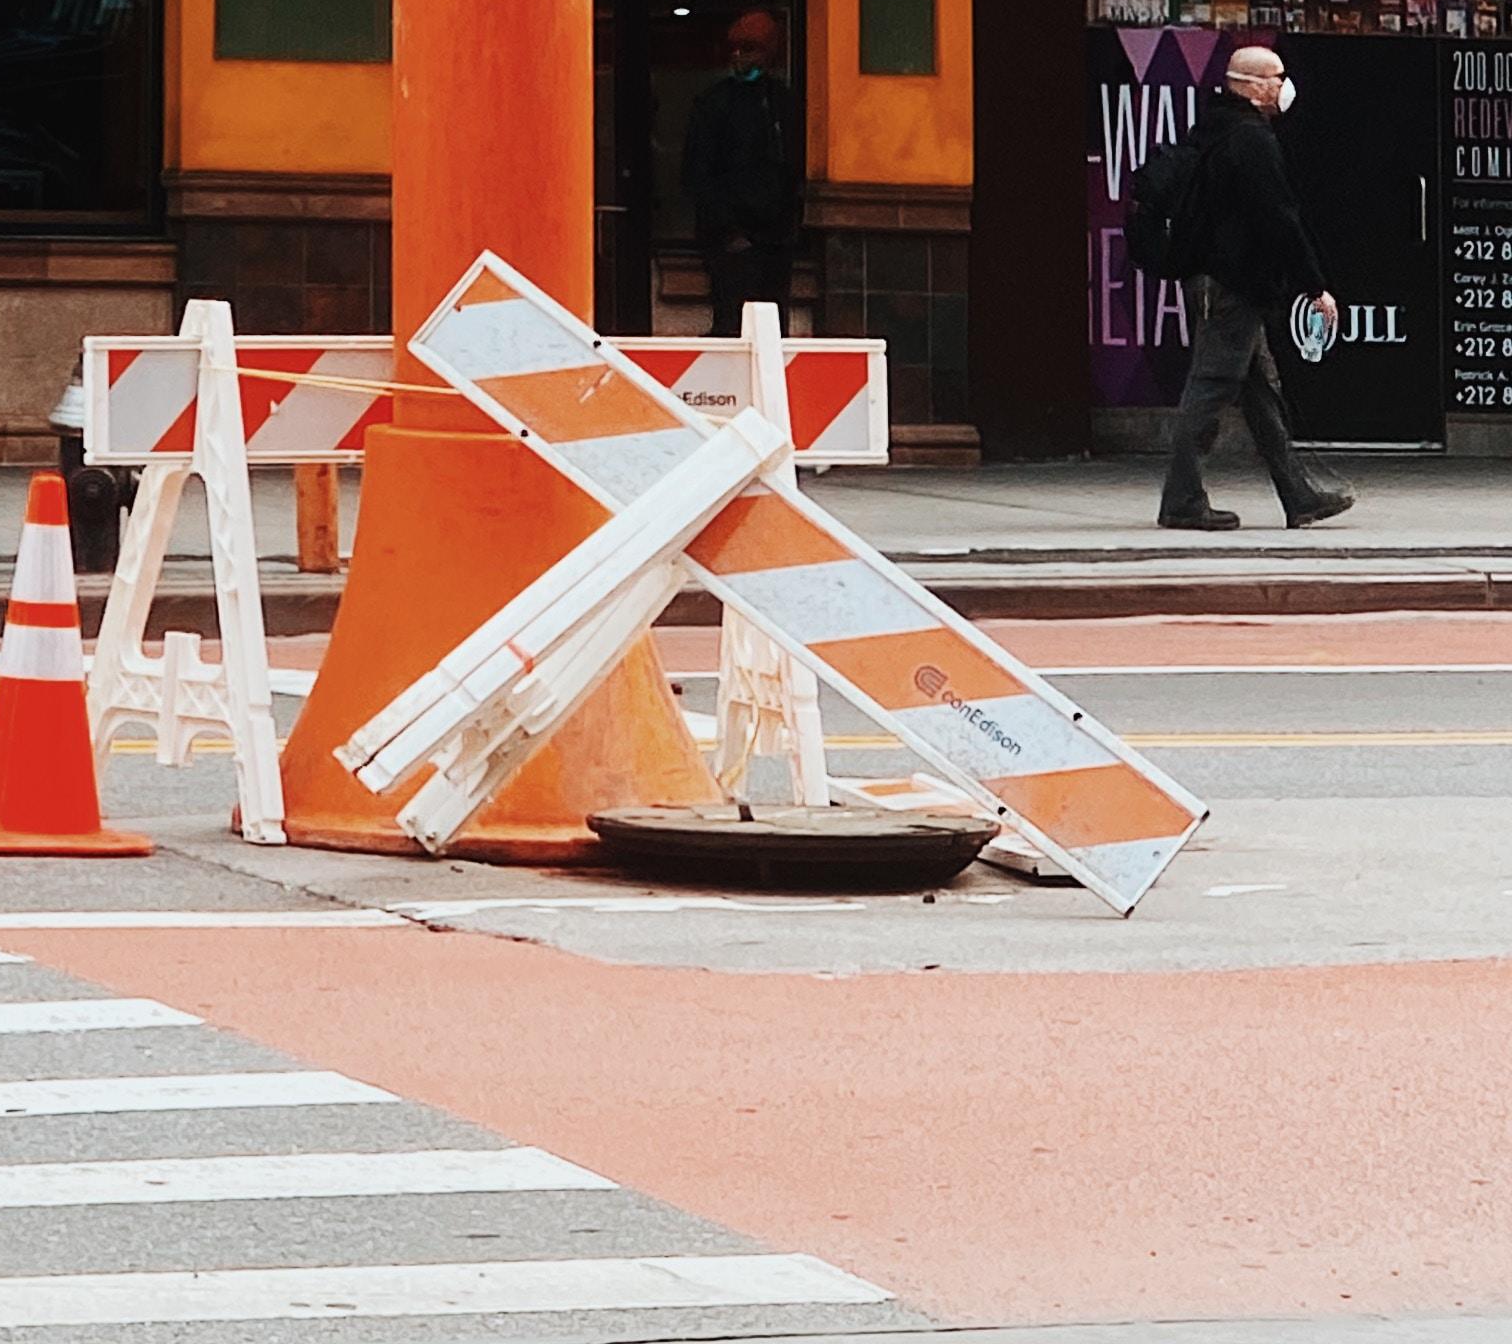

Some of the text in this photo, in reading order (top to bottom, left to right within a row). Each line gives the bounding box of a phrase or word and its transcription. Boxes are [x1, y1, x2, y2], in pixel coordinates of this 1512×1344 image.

[1341, 304, 1407, 343] JLL
[676, 391, 737, 407] Edison
[941, 690, 1022, 755] conEdison
